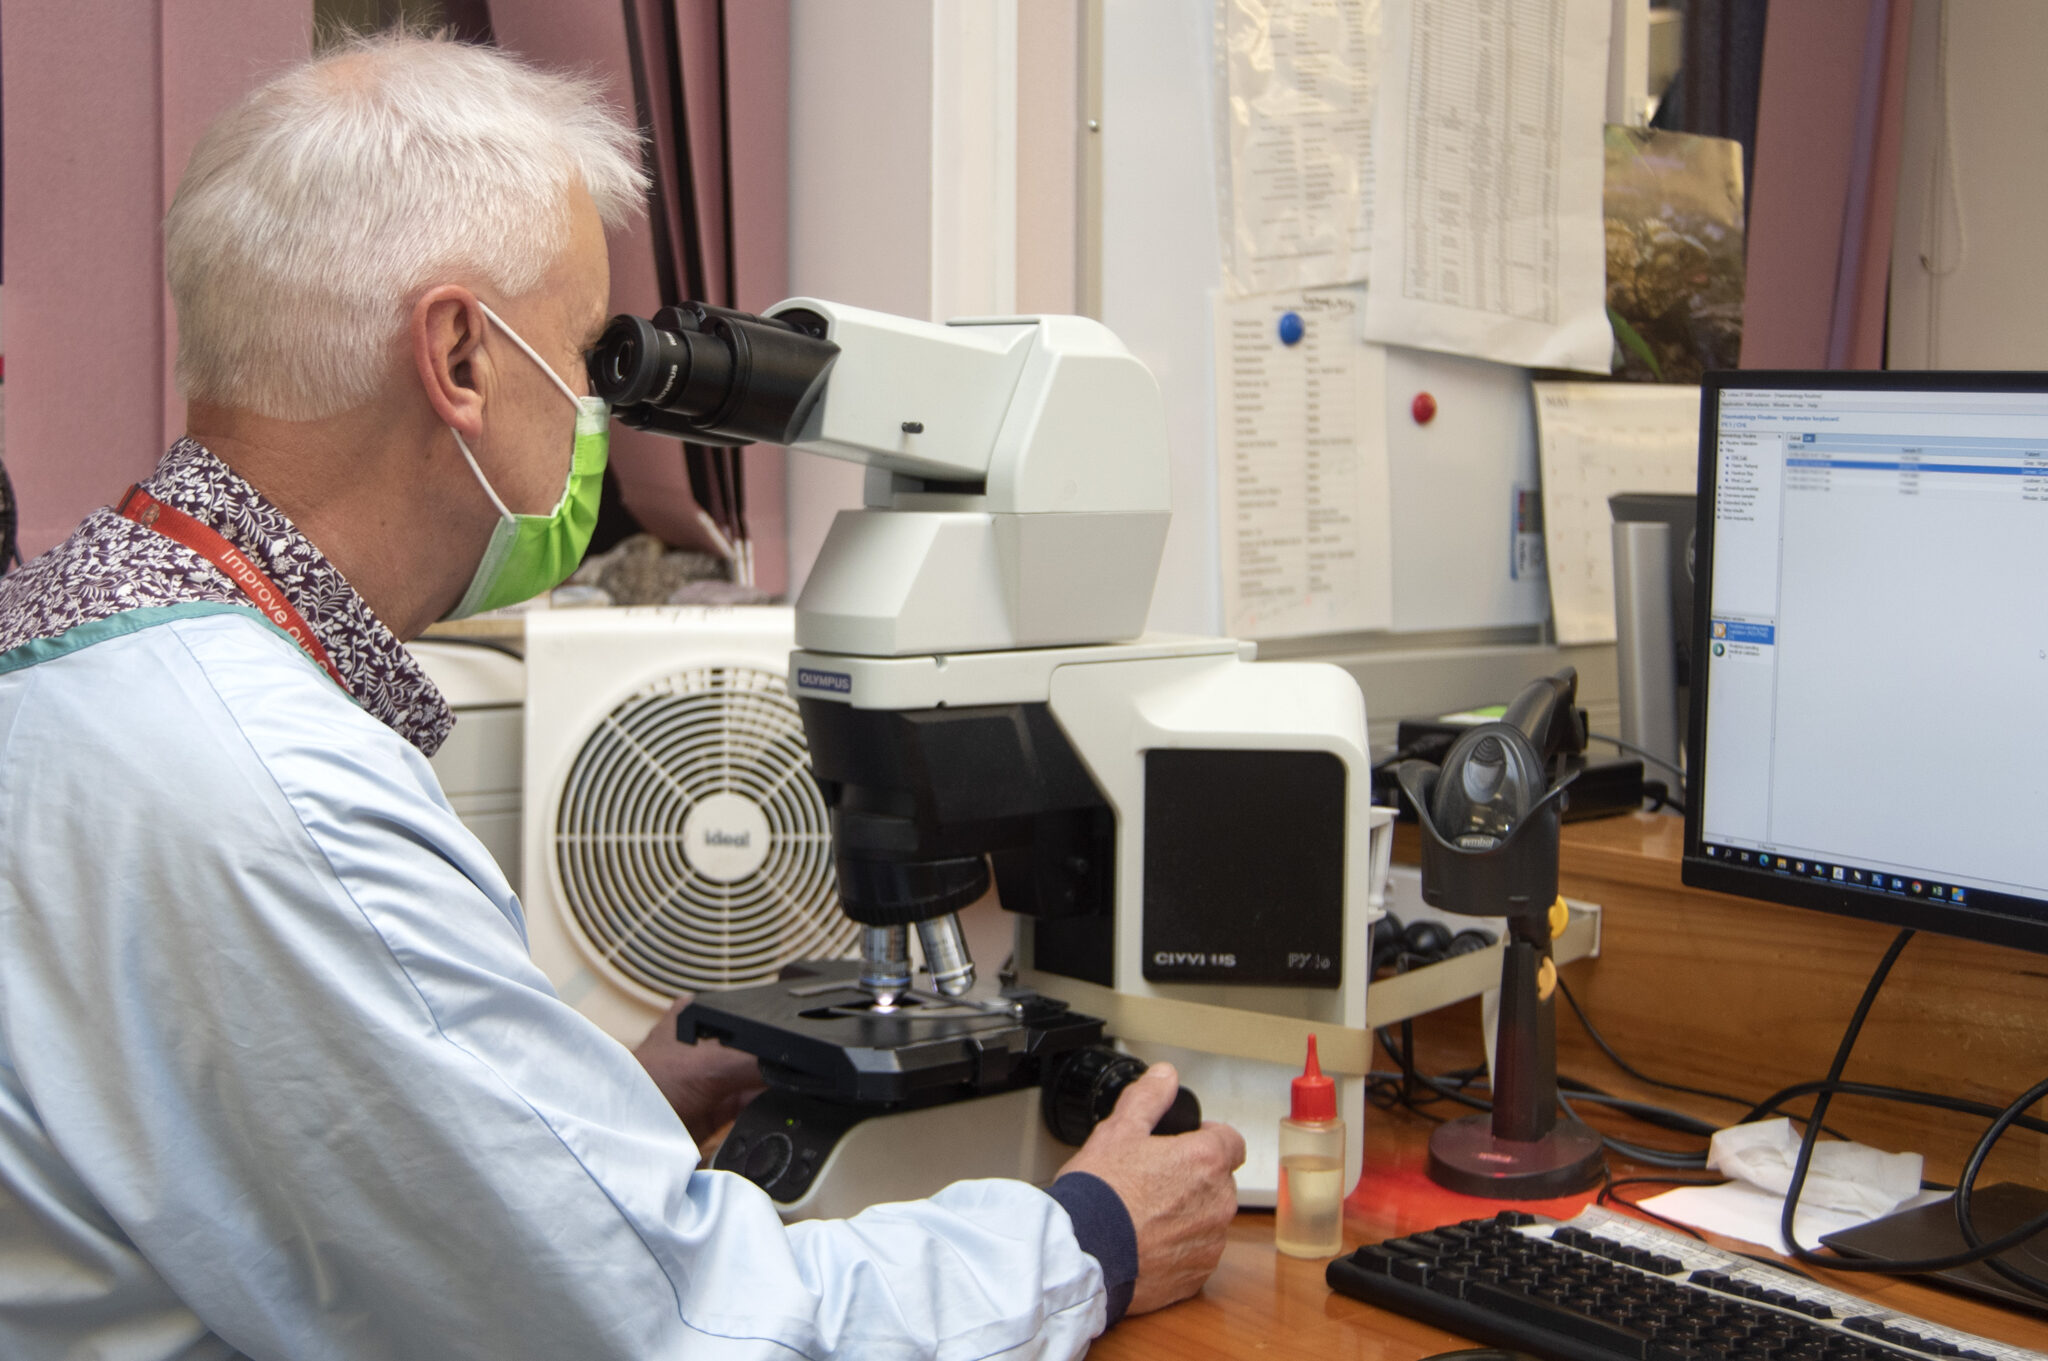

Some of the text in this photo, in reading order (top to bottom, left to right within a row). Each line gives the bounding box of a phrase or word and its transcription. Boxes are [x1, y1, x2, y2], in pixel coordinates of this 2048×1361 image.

[221, 548, 288, 624] Improve
[800, 672, 850, 690] OLYMPUS
[705, 829, 751, 848] ideal
